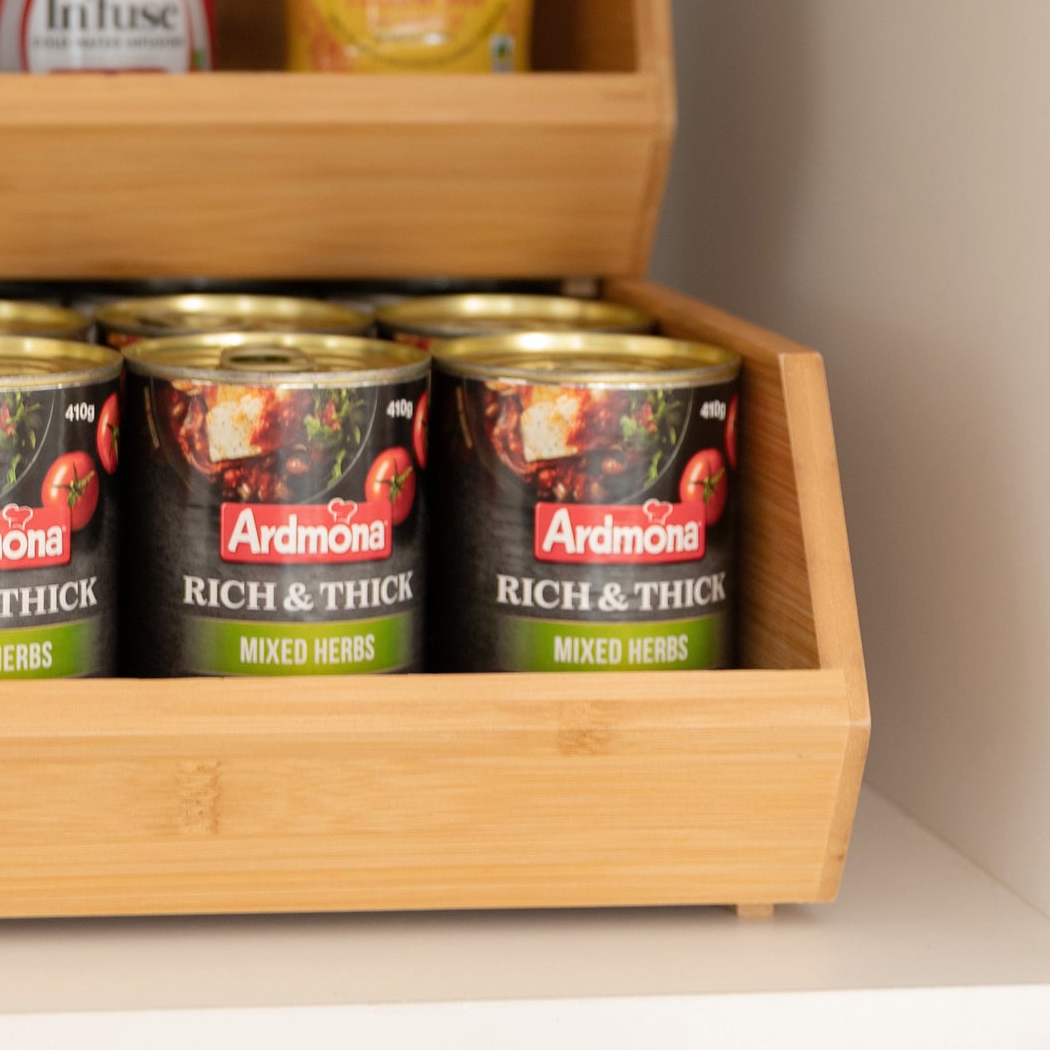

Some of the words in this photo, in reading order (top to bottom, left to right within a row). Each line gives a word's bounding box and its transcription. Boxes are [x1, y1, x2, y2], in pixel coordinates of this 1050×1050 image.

[65, 403, 95, 423] 410g
[386, 399, 413, 419] 410g
[228, 508, 385, 555] Ardmona
[542, 508, 699, 555] Ardmona
[183, 575, 277, 611] RICH
[283, 582, 314, 612] &
[321, 571, 414, 610] THICK
[496, 574, 591, 610] RICH
[598, 582, 629, 611] &
[634, 572, 727, 611] THICK
[240, 636, 307, 665] MIXED
[314, 634, 375, 664] HERBS
[554, 636, 621, 664] MIXED
[629, 634, 689, 663] HERBS
